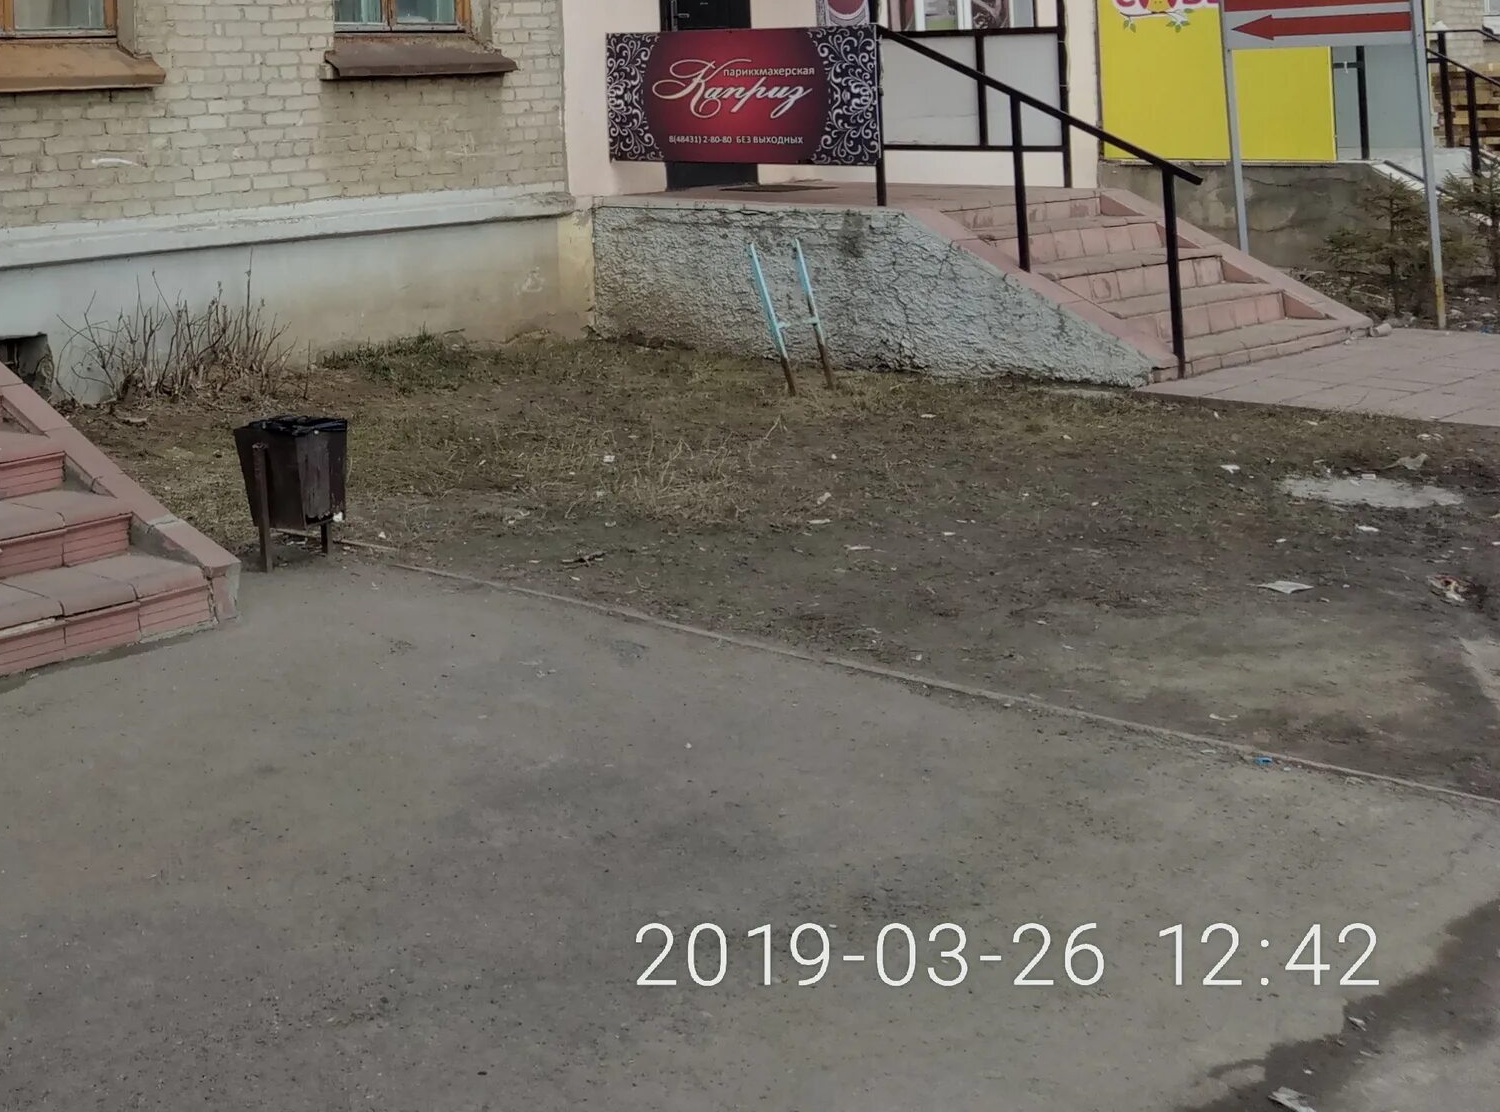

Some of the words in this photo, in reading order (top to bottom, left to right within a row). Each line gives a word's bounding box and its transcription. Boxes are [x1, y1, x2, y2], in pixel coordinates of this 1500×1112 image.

[652, 58, 813, 119] Каприз
[736, 135, 752, 144] БЕЗ
[753, 135, 804, 146] ВЫХОДНЫХ
